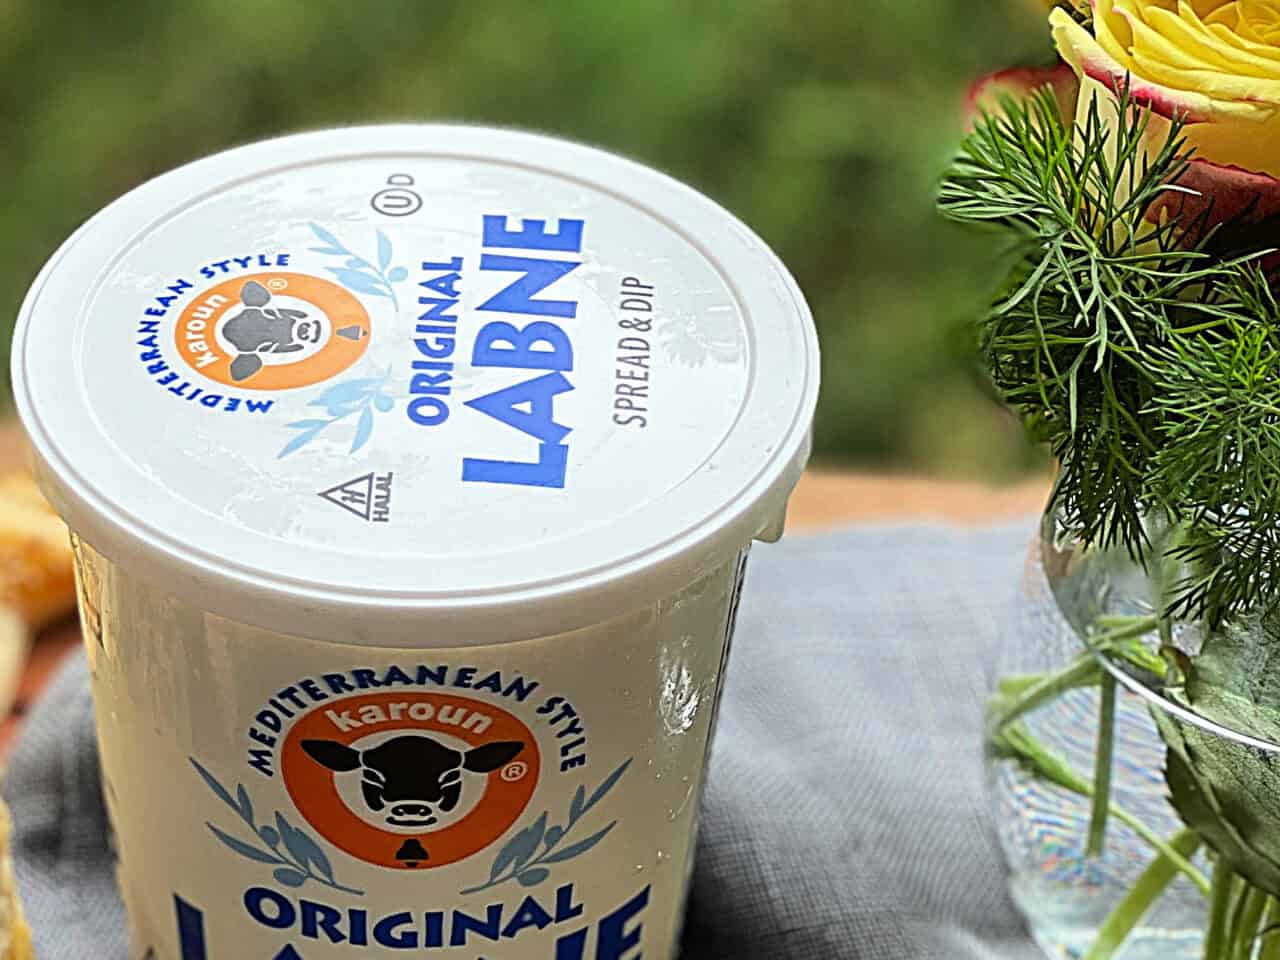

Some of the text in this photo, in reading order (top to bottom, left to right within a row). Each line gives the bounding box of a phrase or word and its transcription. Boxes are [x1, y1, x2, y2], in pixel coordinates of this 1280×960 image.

[136, 253, 291, 414] MEDITERRANEAN STYLE
[184, 293, 229, 369] karoun
[406, 256, 464, 427] ORIGINAL
[461, 214, 585, 489] LABNE
[612, 276, 655, 428] SPREAD & DIP
[372, 471, 394, 523] HALAL
[247, 664, 587, 777] MEDITERRANEAN STYLE
[324, 700, 494, 735] karoun
[242, 882, 584, 949] ORIGINAL
